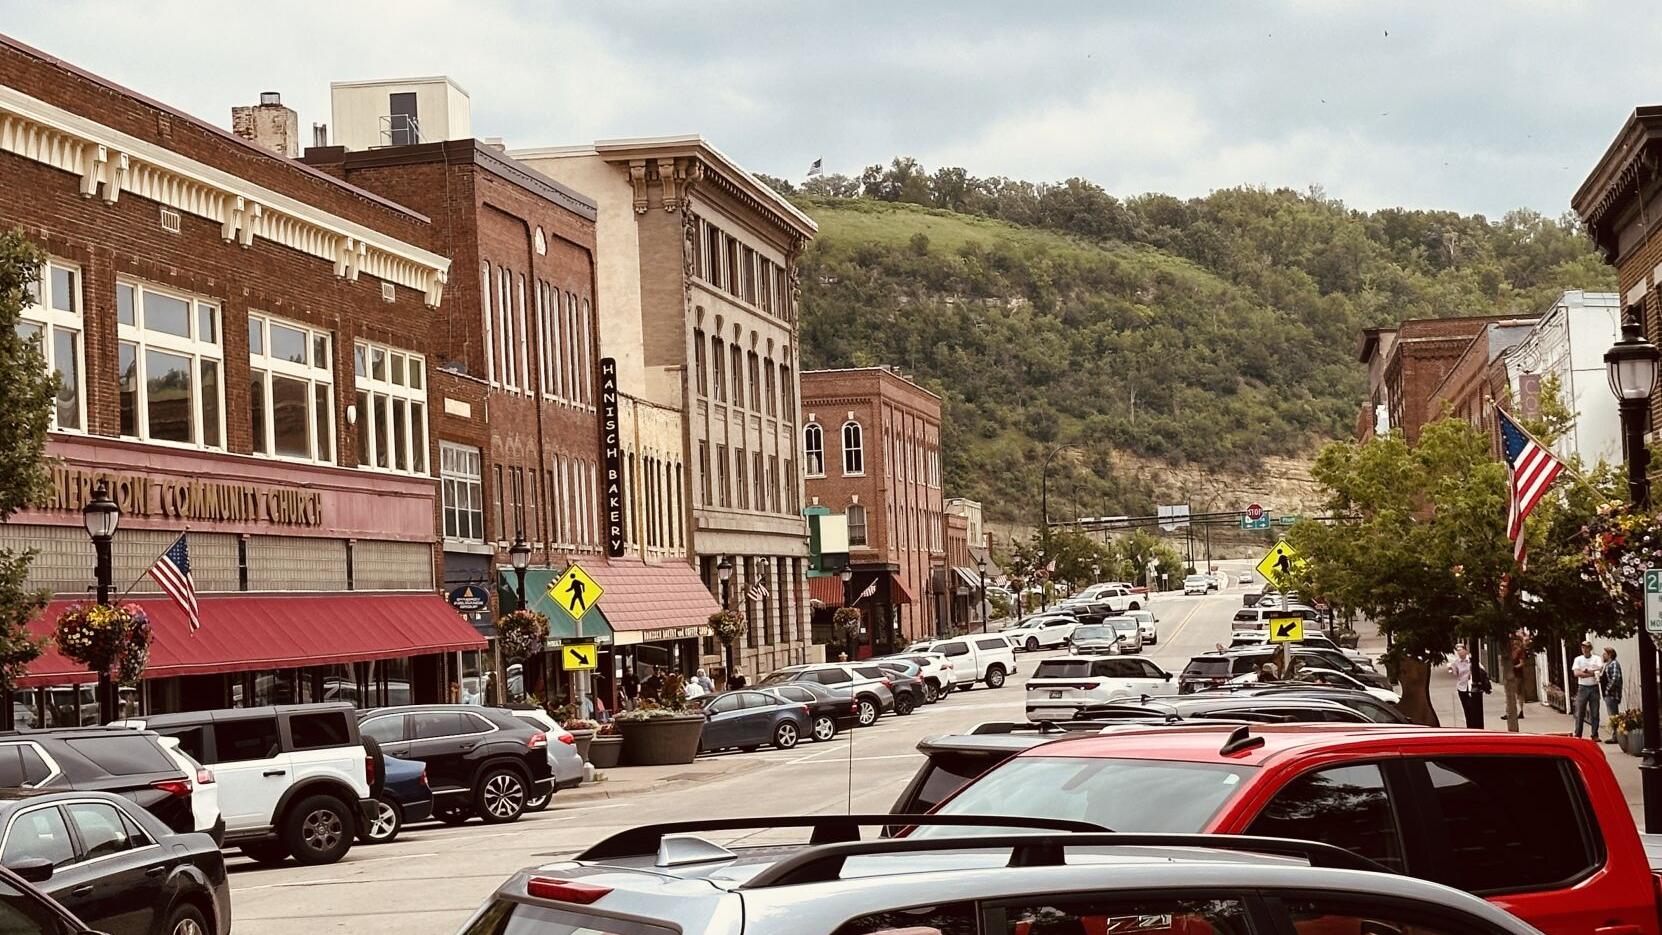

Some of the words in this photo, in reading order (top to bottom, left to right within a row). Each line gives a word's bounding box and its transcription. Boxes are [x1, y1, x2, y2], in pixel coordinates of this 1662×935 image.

[603, 364, 617, 459] HANISCH
[47, 468, 156, 516] NERTONE
[161, 479, 265, 522] COMMUNITY
[266, 489, 323, 526] CHURCH
[608, 468, 621, 551] BAKERY
[1248, 508, 1261, 516] STOP
[1647, 574, 1658, 590] 2
